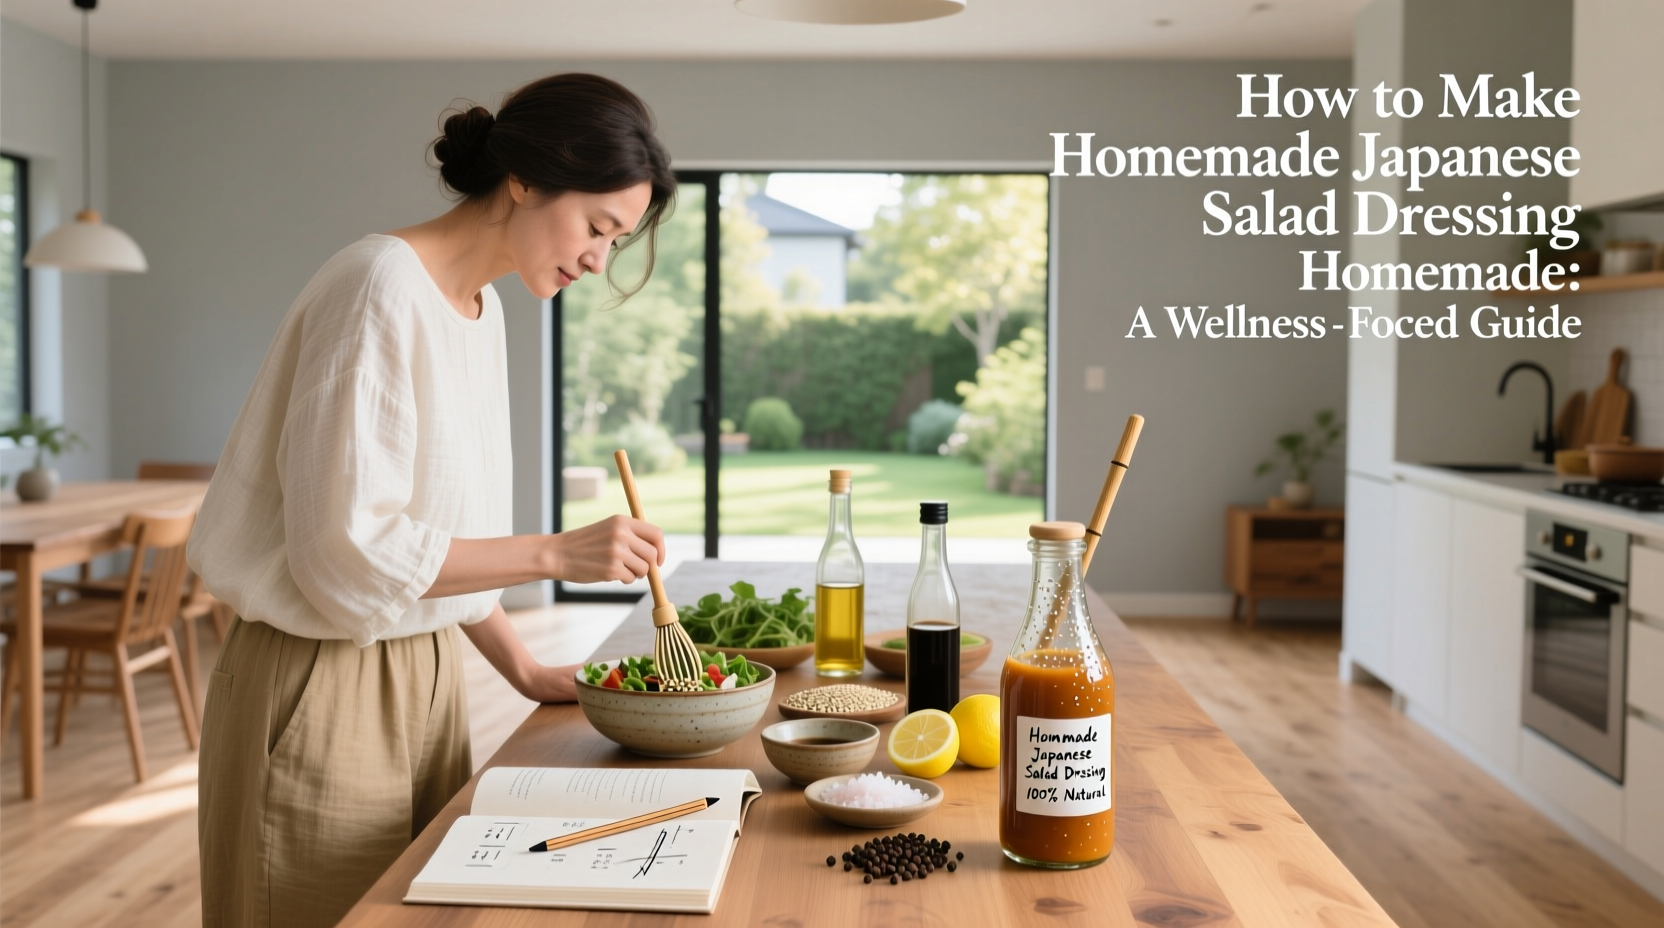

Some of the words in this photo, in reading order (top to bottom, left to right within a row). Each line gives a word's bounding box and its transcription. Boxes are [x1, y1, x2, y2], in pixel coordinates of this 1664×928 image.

[1030, 747, 1093, 768] Japanese
[1024, 764, 1058, 780] Salad
[1026, 787, 1058, 803] 100%
[1063, 784, 1106, 802] Natural
